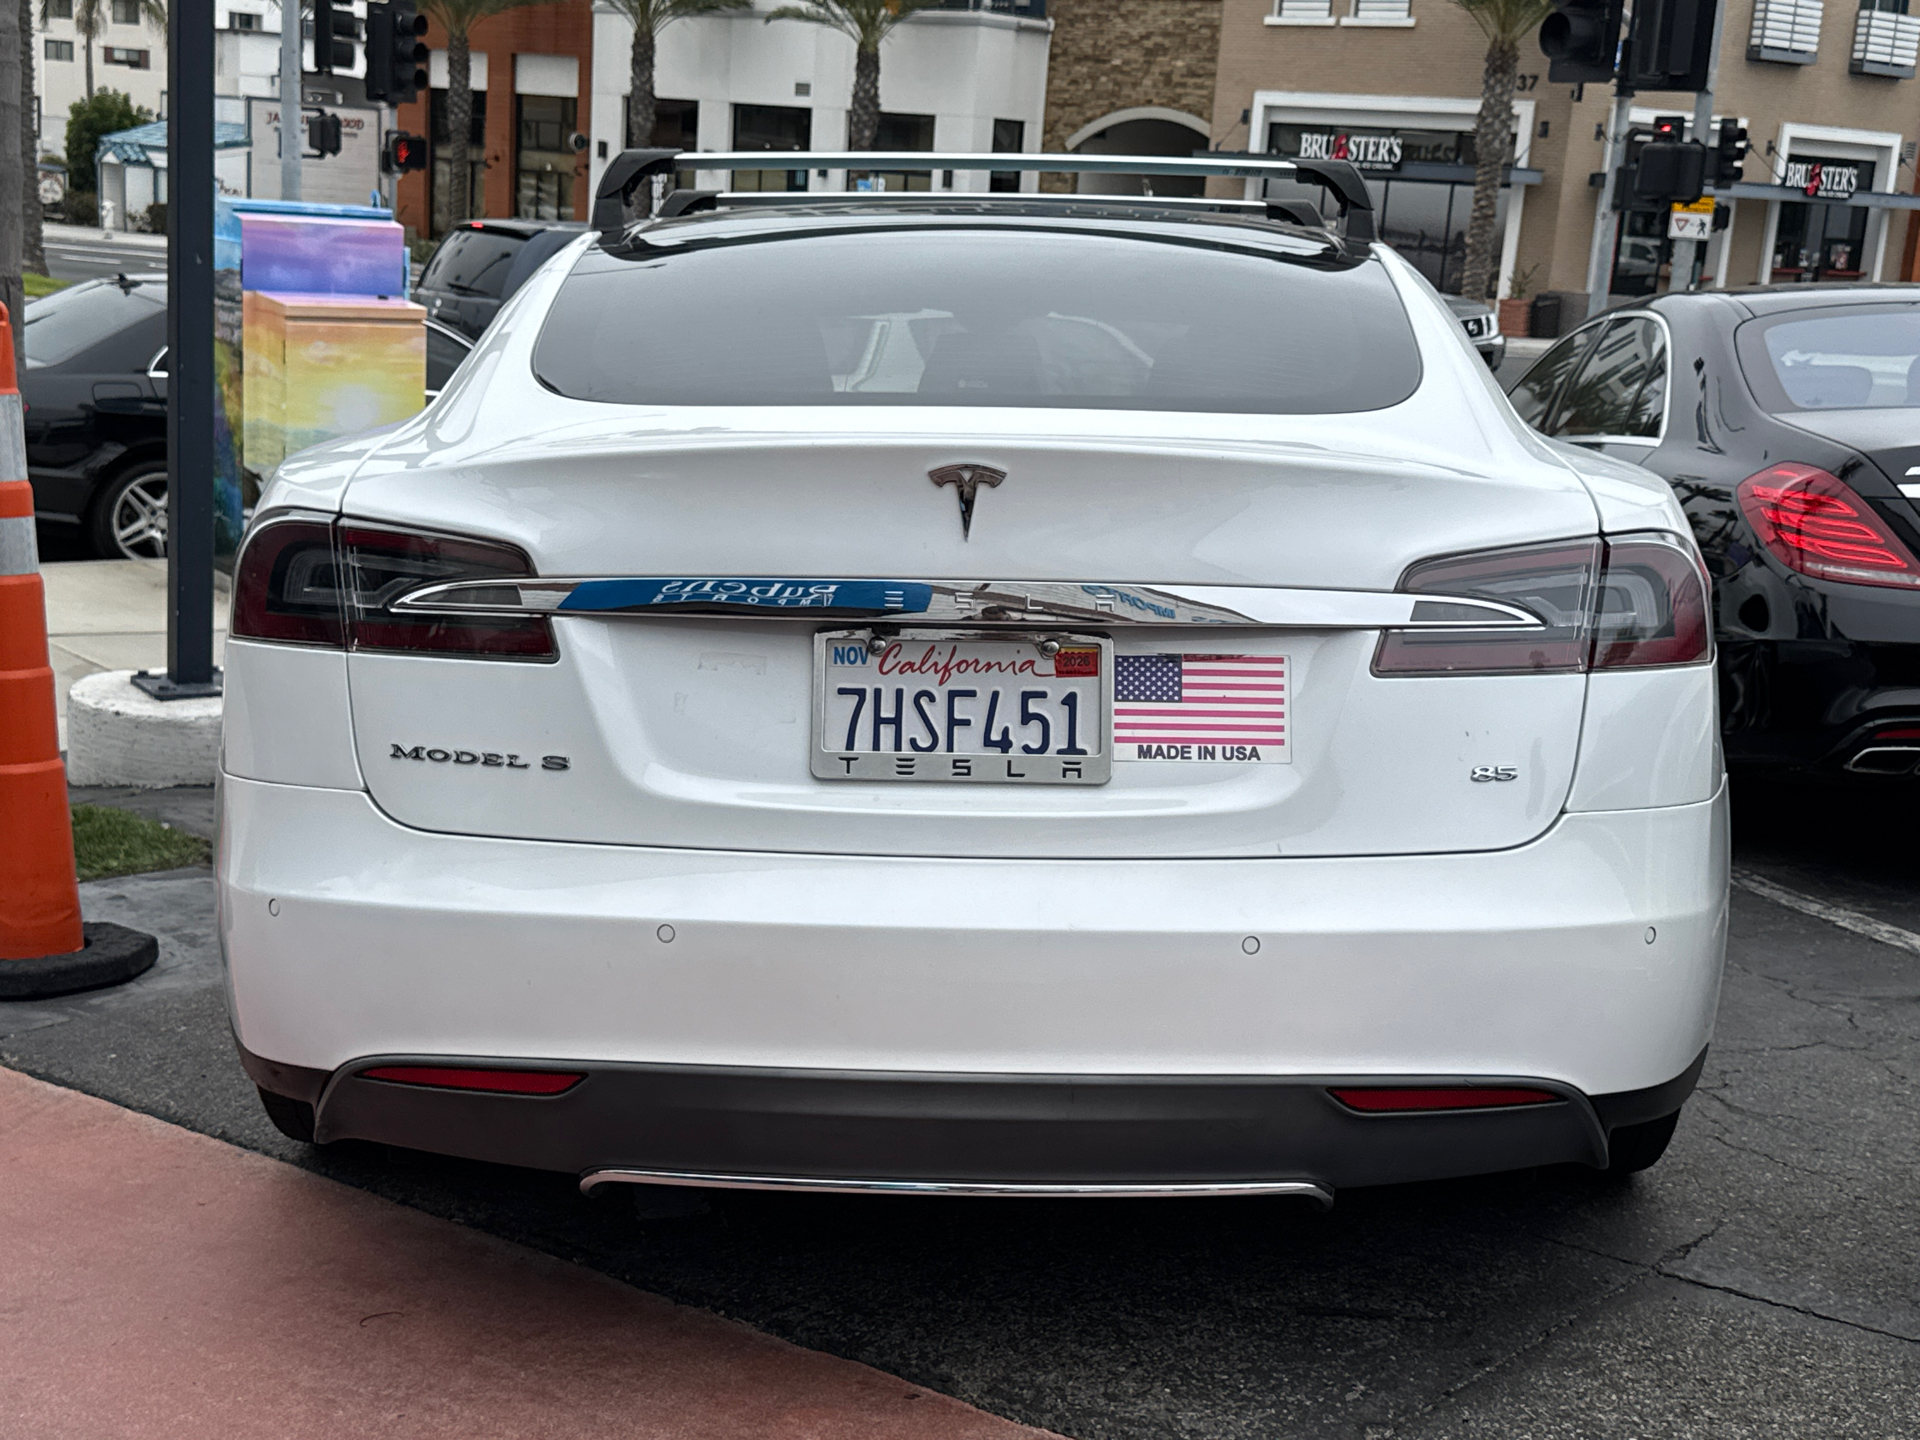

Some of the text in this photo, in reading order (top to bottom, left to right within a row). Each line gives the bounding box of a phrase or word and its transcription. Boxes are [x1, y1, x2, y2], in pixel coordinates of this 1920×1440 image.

[833, 643, 1091, 686] NOV California 2026
[837, 687, 1088, 755] 7HSF451
[389, 743, 571, 771] MODEL S
[1137, 744, 1261, 761] MADE IN USA
[838, 757, 1082, 779] TESLA
[1470, 764, 1518, 782] 85
